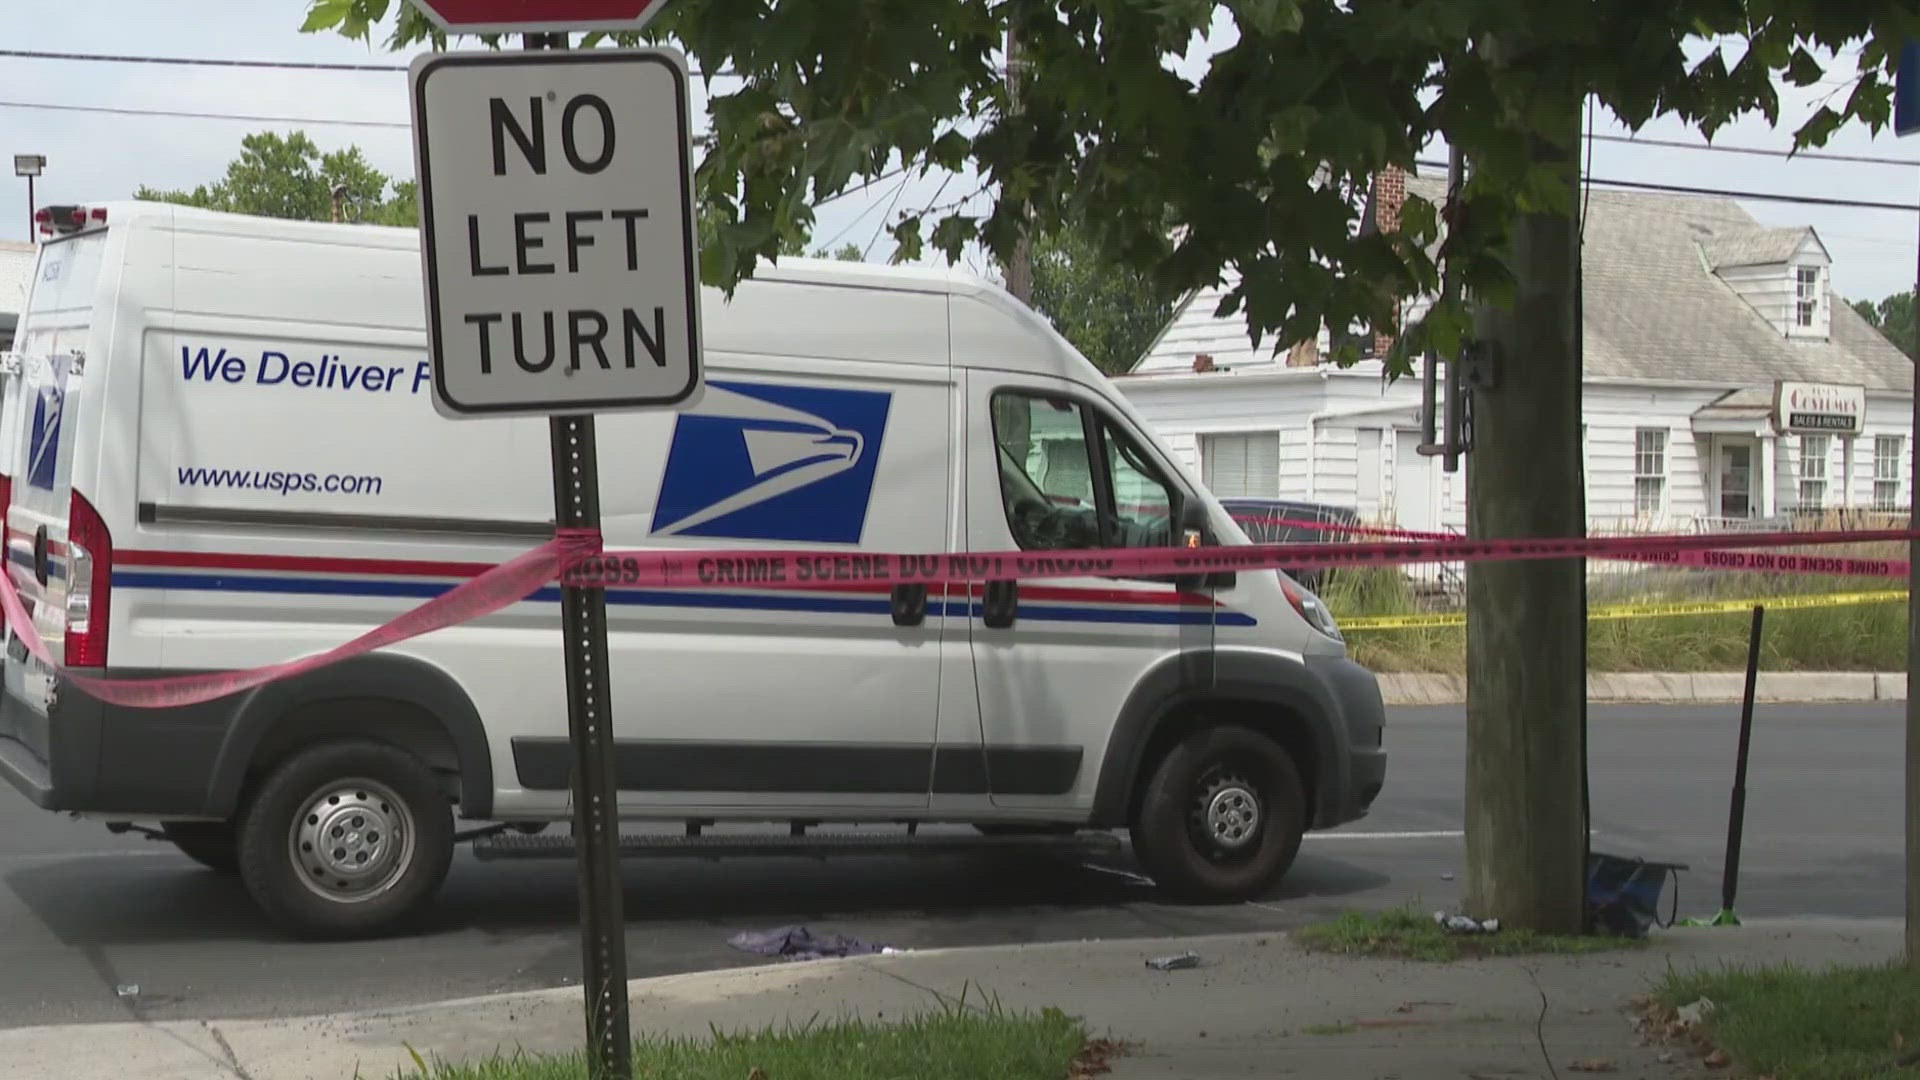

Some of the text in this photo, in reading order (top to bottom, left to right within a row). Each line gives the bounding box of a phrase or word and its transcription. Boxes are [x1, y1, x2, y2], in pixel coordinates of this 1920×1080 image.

[489, 93, 616, 176] NO
[468, 208, 649, 277] LEFT
[464, 306, 667, 375] TURN
[181, 345, 246, 383] We
[256, 350, 404, 392] Deliver
[178, 466, 383, 495] www.usps.com
[698, 556, 787, 583] CRIME
[796, 554, 890, 581] SCENE
[899, 554, 939, 577] DO
[949, 555, 1003, 577] NOT
[1703, 551, 1889, 575] CRIME SCENE DO NOT CROSS
